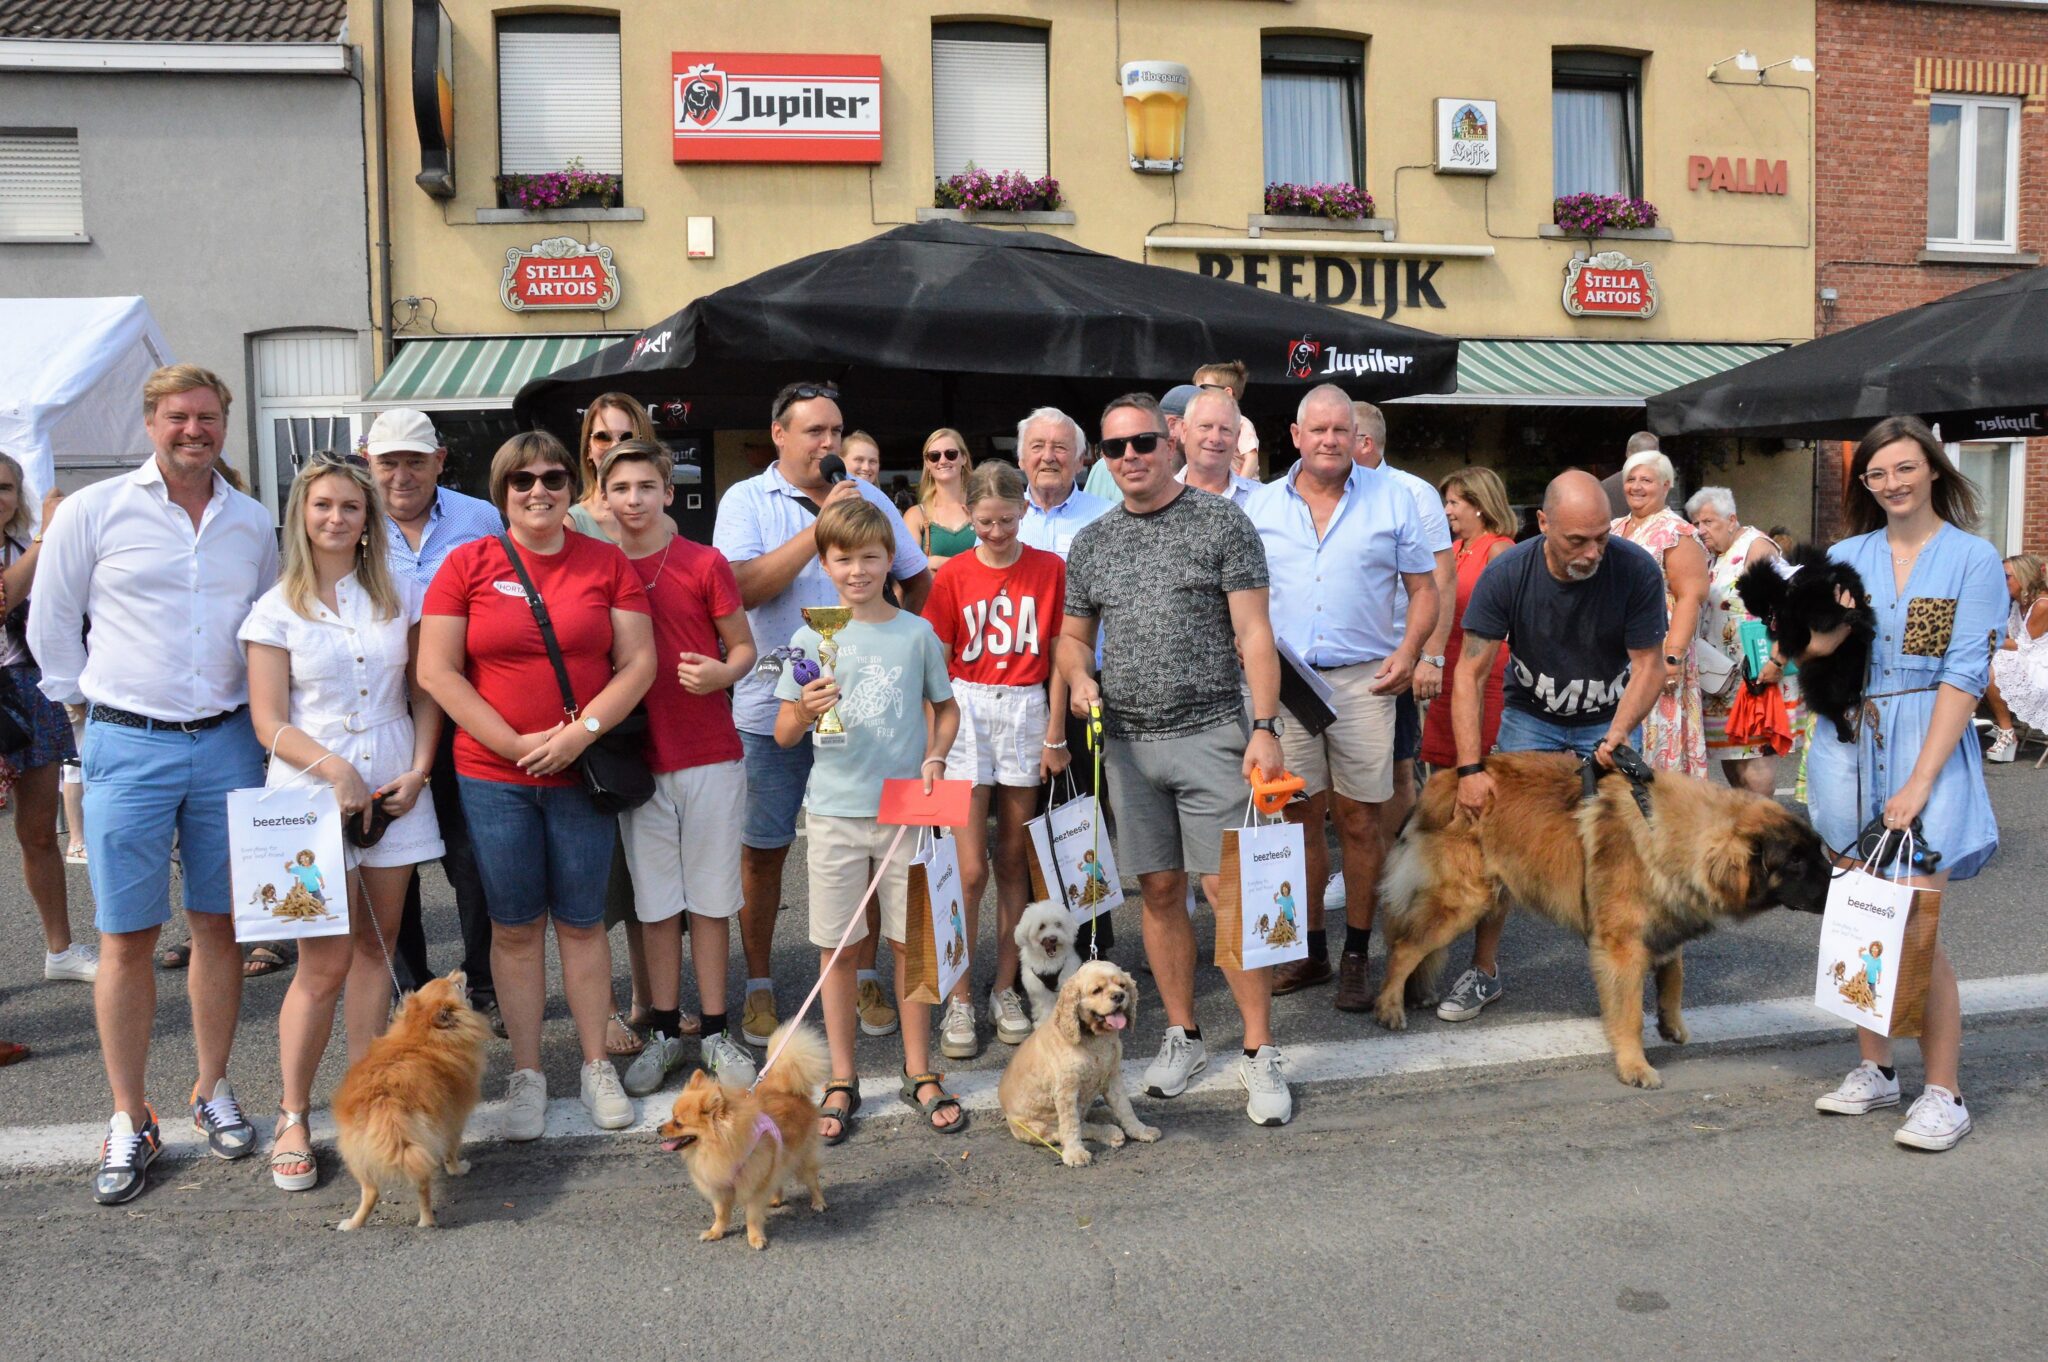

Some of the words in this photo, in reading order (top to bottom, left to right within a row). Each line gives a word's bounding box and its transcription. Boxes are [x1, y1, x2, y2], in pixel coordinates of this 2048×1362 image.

[727, 86, 870, 127] Jupiler
[1450, 141, 1490, 166] Leffe
[1687, 155, 1788, 195] PALM
[526, 265, 595, 279] STELLA
[1584, 273, 1640, 289] STELLA
[526, 281, 597, 296] ARTOIS
[1584, 290, 1641, 305] ARTOIS
[1320, 346, 1414, 378] Jupiler
[961, 595, 1039, 662] USA
[253, 816, 305, 828] beeztees
[1053, 825, 1083, 844] eeztees
[1253, 851, 1284, 862] beeztees
[1847, 896, 1887, 917] beeztees
